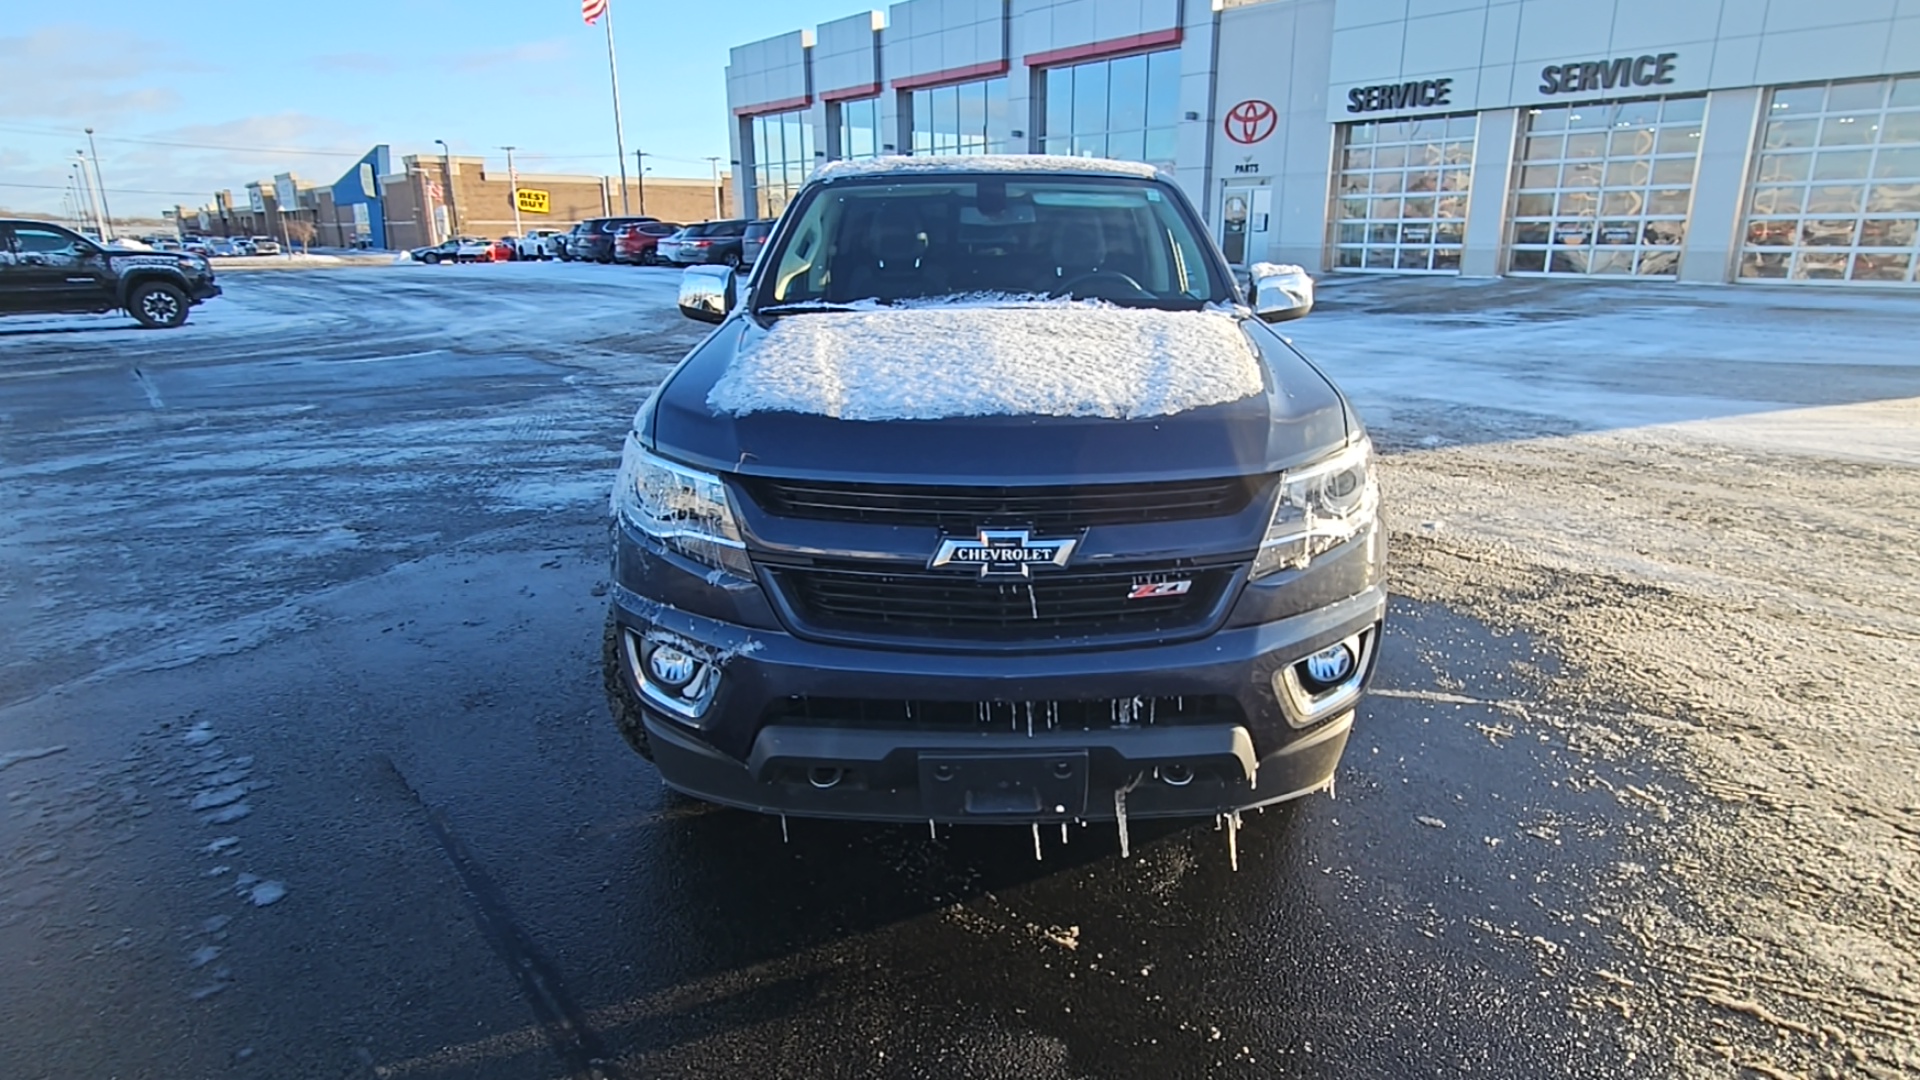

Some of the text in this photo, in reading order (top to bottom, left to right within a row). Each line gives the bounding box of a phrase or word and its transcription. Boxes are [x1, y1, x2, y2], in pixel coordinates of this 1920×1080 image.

[1539, 52, 1678, 95] SERVICE
[1347, 79, 1453, 113] SERVICE
[1235, 164, 1259, 173] PARTS
[519, 192, 546, 201] BEST
[520, 200, 544, 208] BUY
[957, 548, 1052, 561] CHEVROLET
